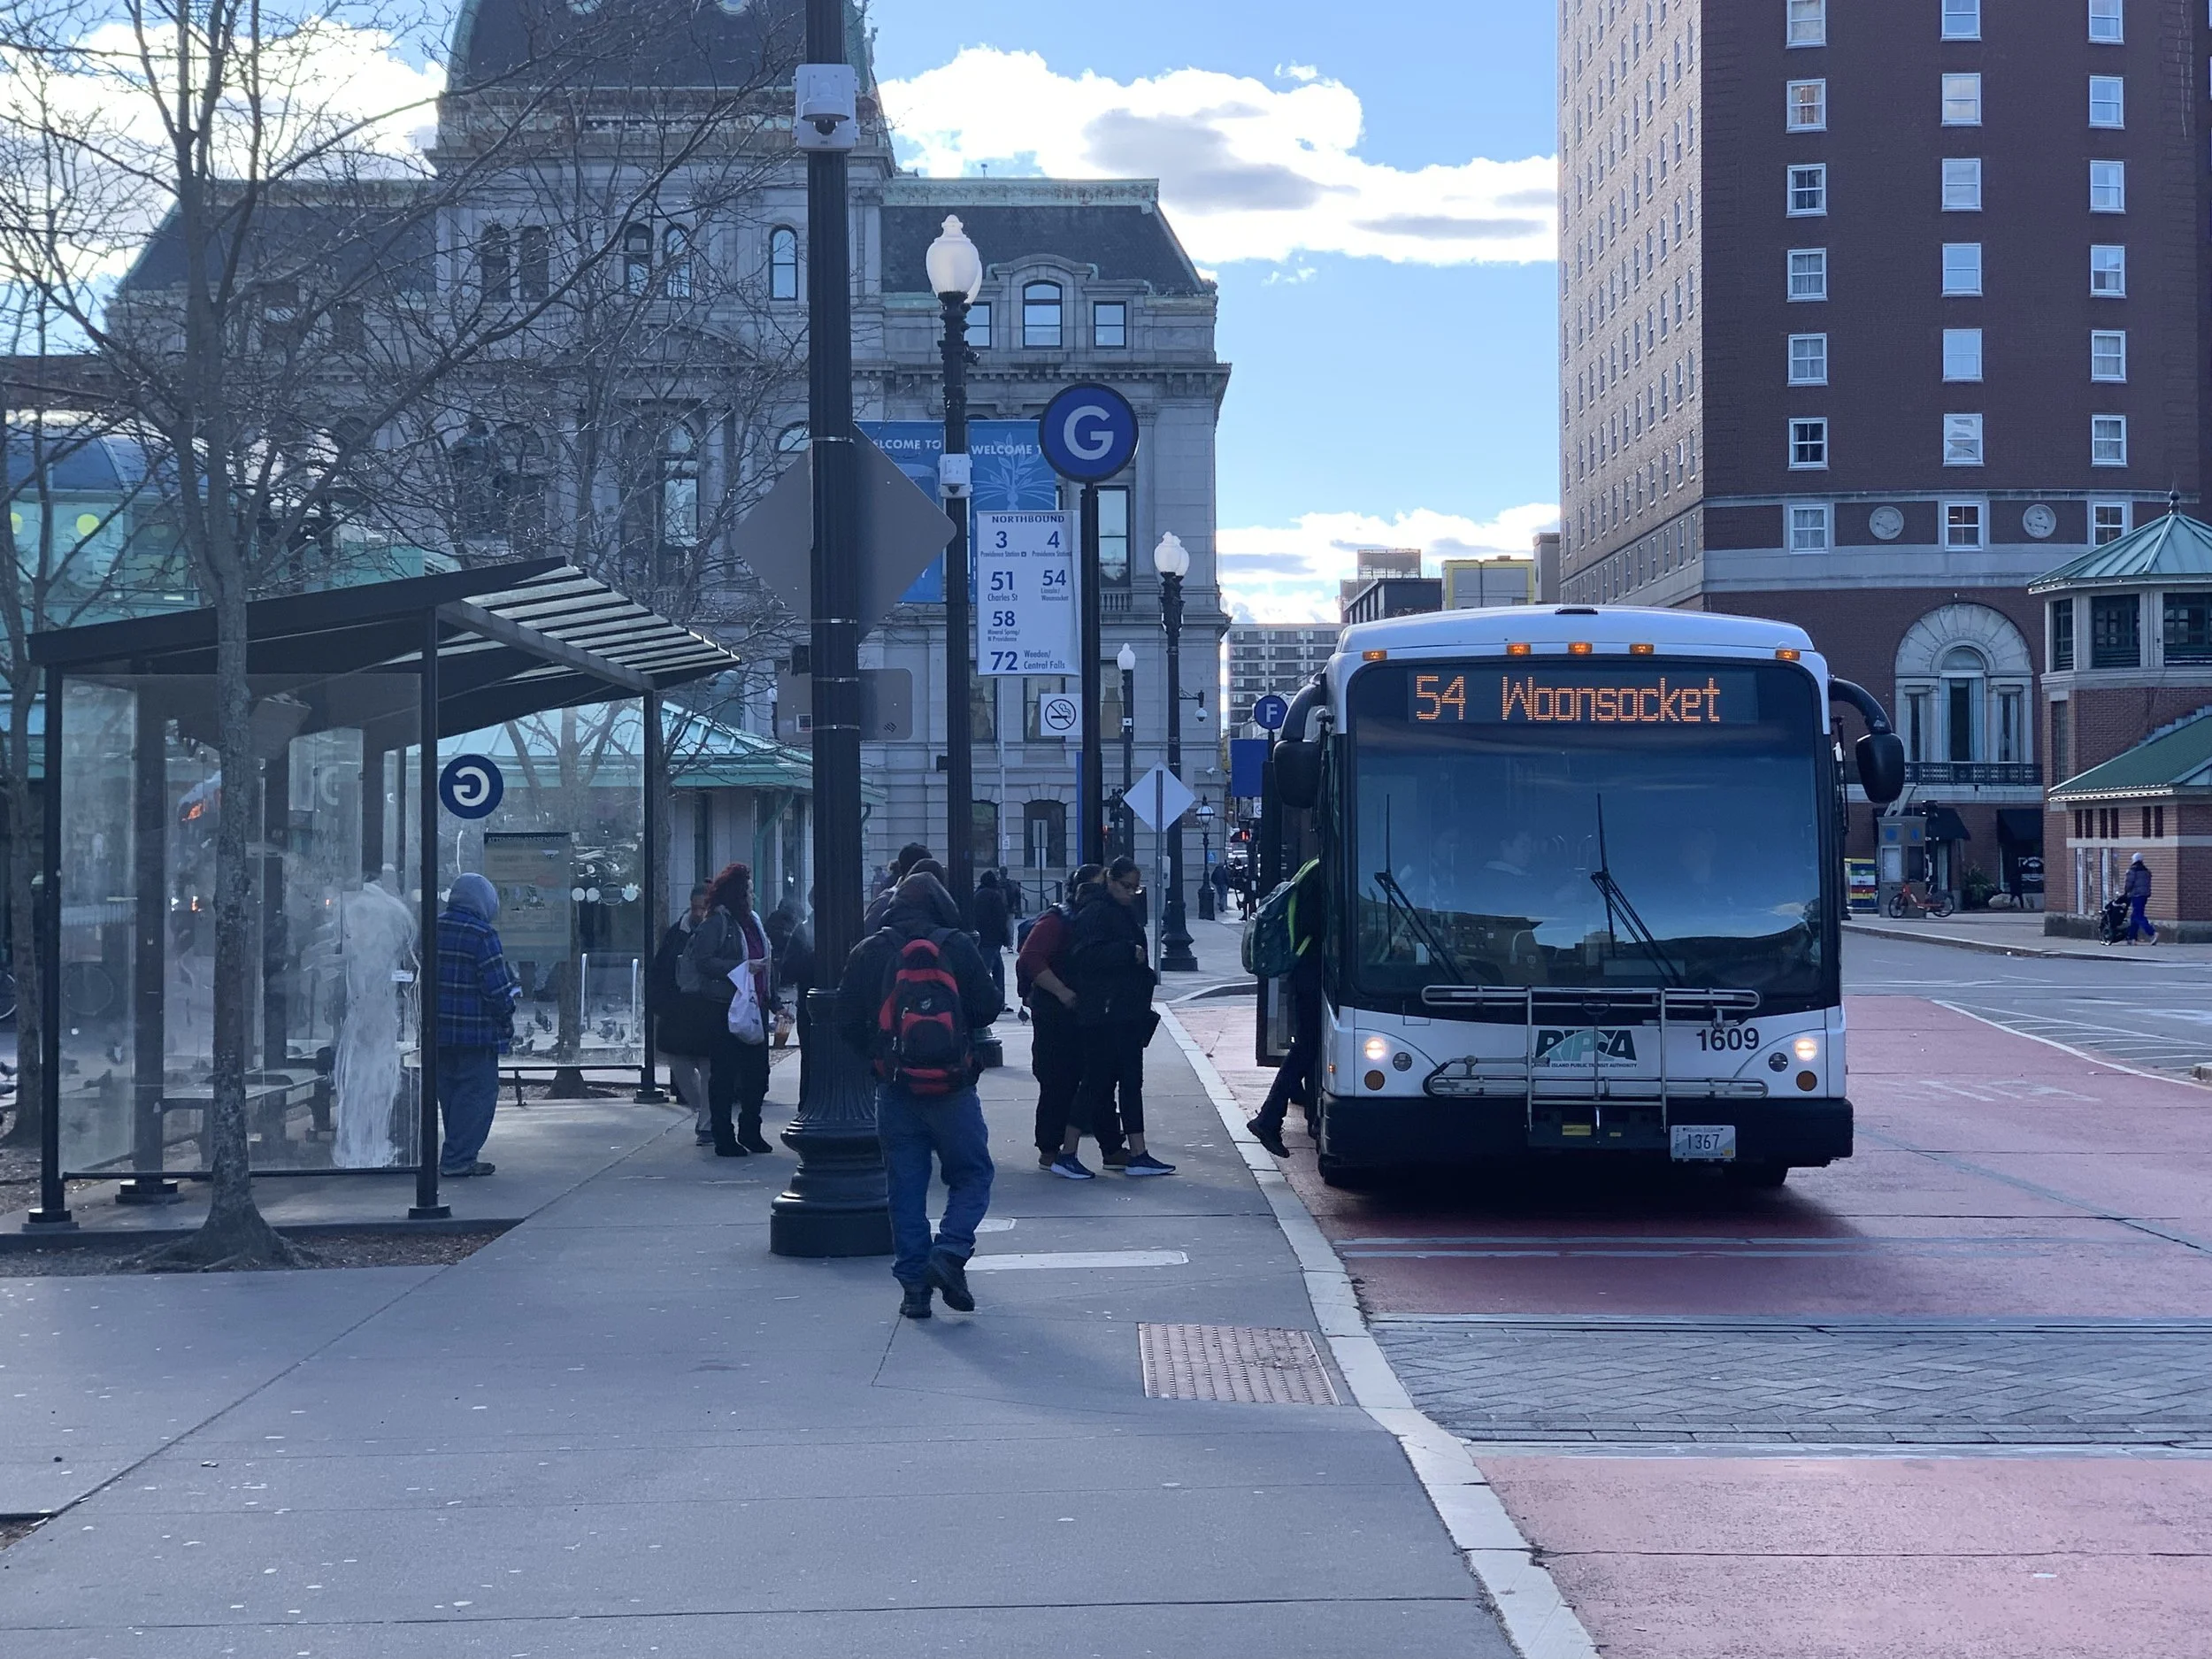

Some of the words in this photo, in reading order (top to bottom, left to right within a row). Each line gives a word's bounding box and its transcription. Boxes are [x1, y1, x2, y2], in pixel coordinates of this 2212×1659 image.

[1063, 404, 1115, 460] G
[926, 439, 942, 450] TO
[971, 444, 1033, 455] WELCOME
[995, 531, 1008, 549] 3
[1047, 531, 1060, 549] 4
[990, 571, 1013, 591] 51
[1042, 569, 1066, 586] 54
[993, 611, 1016, 627] 58
[990, 650, 1018, 671] 72
[1024, 661, 1048, 670] Central
[1050, 661, 1065, 670] Falls
[1416, 675, 1466, 720] 54
[1502, 676, 1720, 722] Woonsocket
[1265, 703, 1278, 723] F
[1534, 1029, 1637, 1061] RIPTA
[1696, 1027, 1759, 1051] 1609
[1687, 1133, 1720, 1149] 1367
